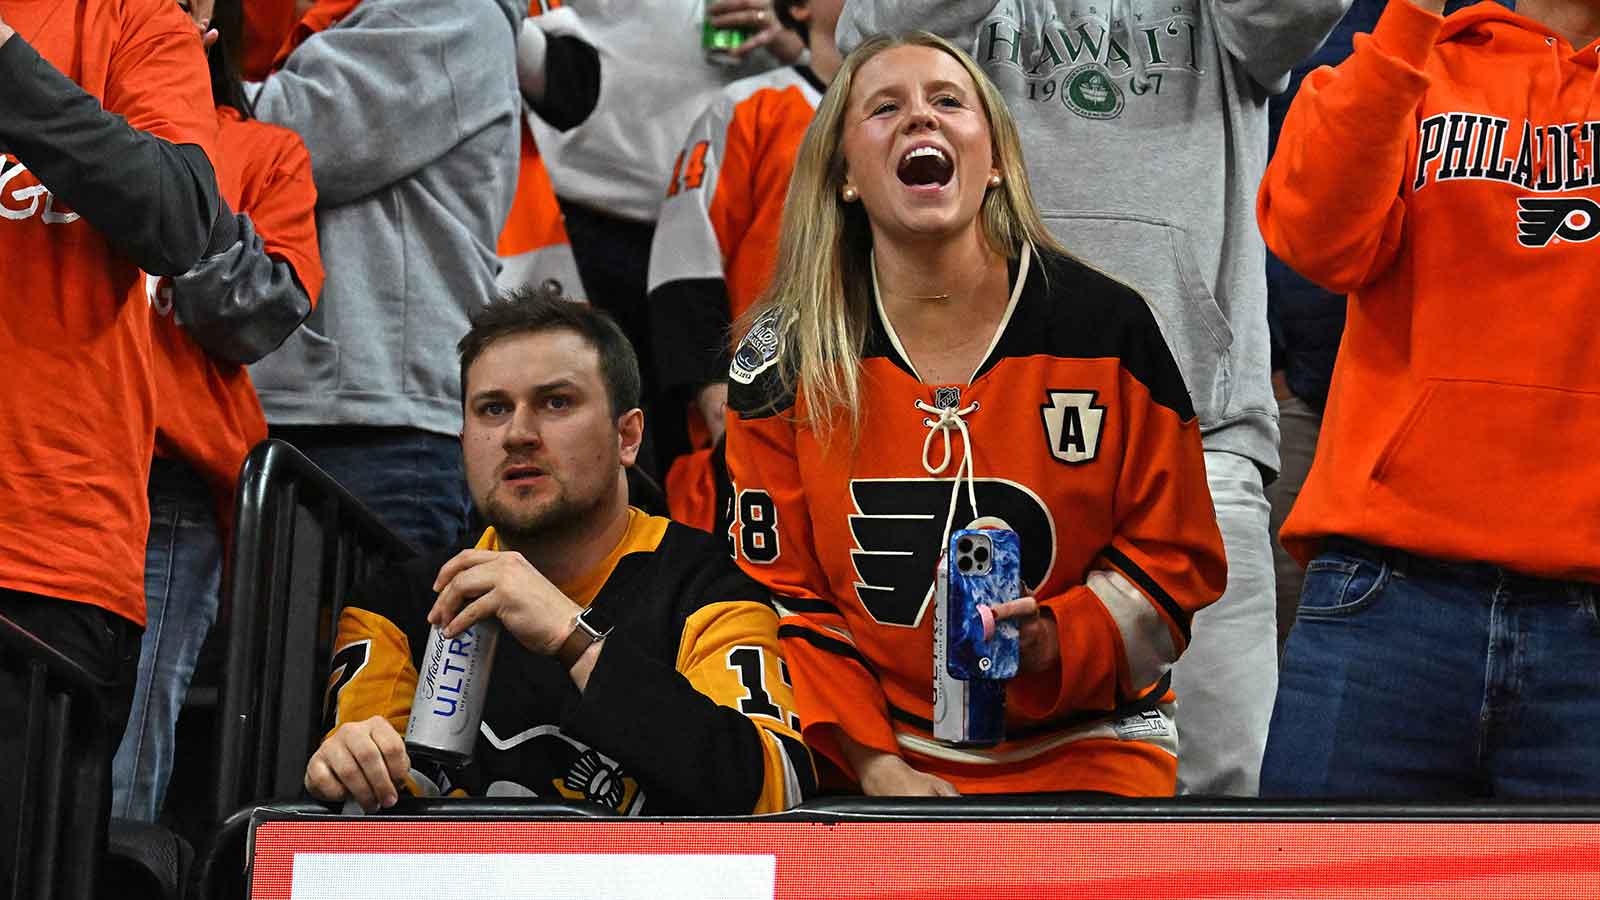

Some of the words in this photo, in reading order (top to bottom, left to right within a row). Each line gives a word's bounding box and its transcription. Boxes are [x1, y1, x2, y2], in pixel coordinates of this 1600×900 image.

[1027, 79, 1057, 103] 19
[1129, 73, 1163, 96] 67
[1059, 406, 1086, 453] A
[728, 485, 781, 564] 8
